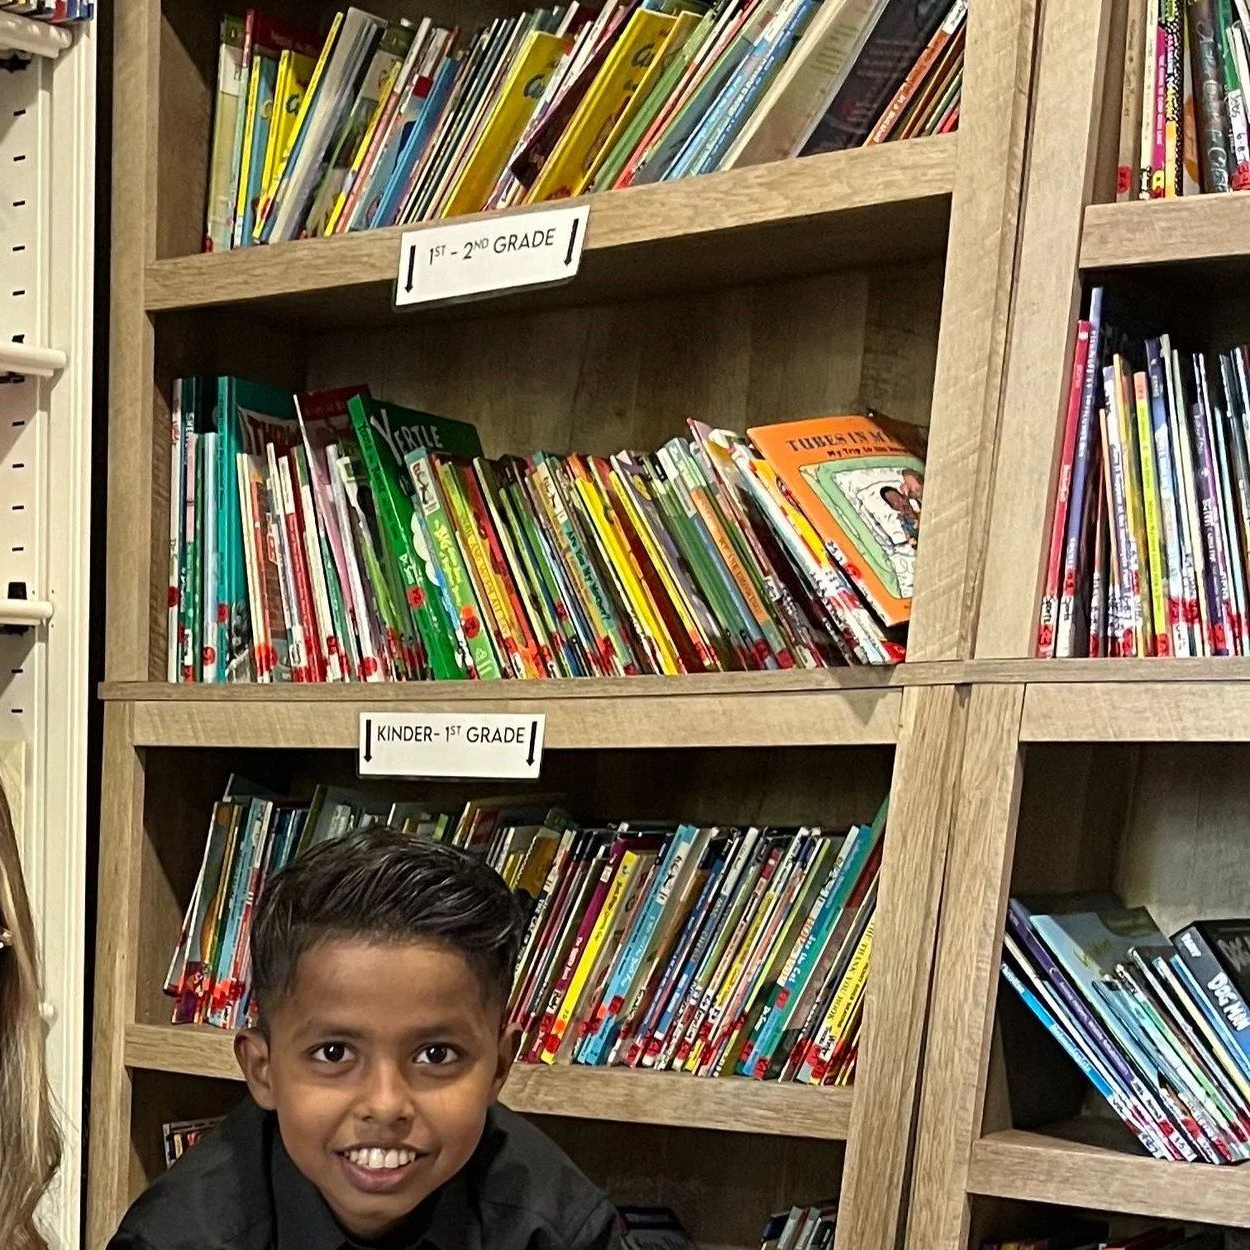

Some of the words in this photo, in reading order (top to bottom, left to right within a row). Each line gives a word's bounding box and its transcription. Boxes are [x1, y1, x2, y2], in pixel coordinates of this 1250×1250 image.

[872, 109, 896, 144] Nutshell
[429, 244, 446, 265] 1ST
[463, 238, 489, 260] 2ND
[493, 228, 556, 254] GRADE
[369, 407, 443, 465] YERTLE
[786, 432, 848, 452] TUBES
[849, 430, 869, 444] IN
[827, 449, 842, 458] My
[844, 448, 861, 456] Trip
[433, 525, 452, 550] BIG
[566, 530, 579, 547] Are
[574, 549, 587, 565] You
[580, 566, 594, 582] My
[588, 582, 611, 621] Mother?
[445, 725, 461, 742] 1ST
[466, 727, 525, 743] GRADE
[528, 915, 538, 931] CAT
[803, 934, 816, 950] See
[1179, 932, 1203, 959] PILKEY
[796, 951, 808, 965] the
[848, 941, 868, 974] THANK
[787, 966, 801, 983] Cat
[856, 962, 870, 982] HENRY
[839, 975, 853, 994] YOU
[848, 983, 860, 1000] GOES
[826, 995, 843, 1021] BOOK
[1205, 970, 1237, 1007] DOG
[1223, 1000, 1250, 1032] MAN
[835, 1001, 852, 1028] SKATING
[818, 1034, 838, 1057] Winter
